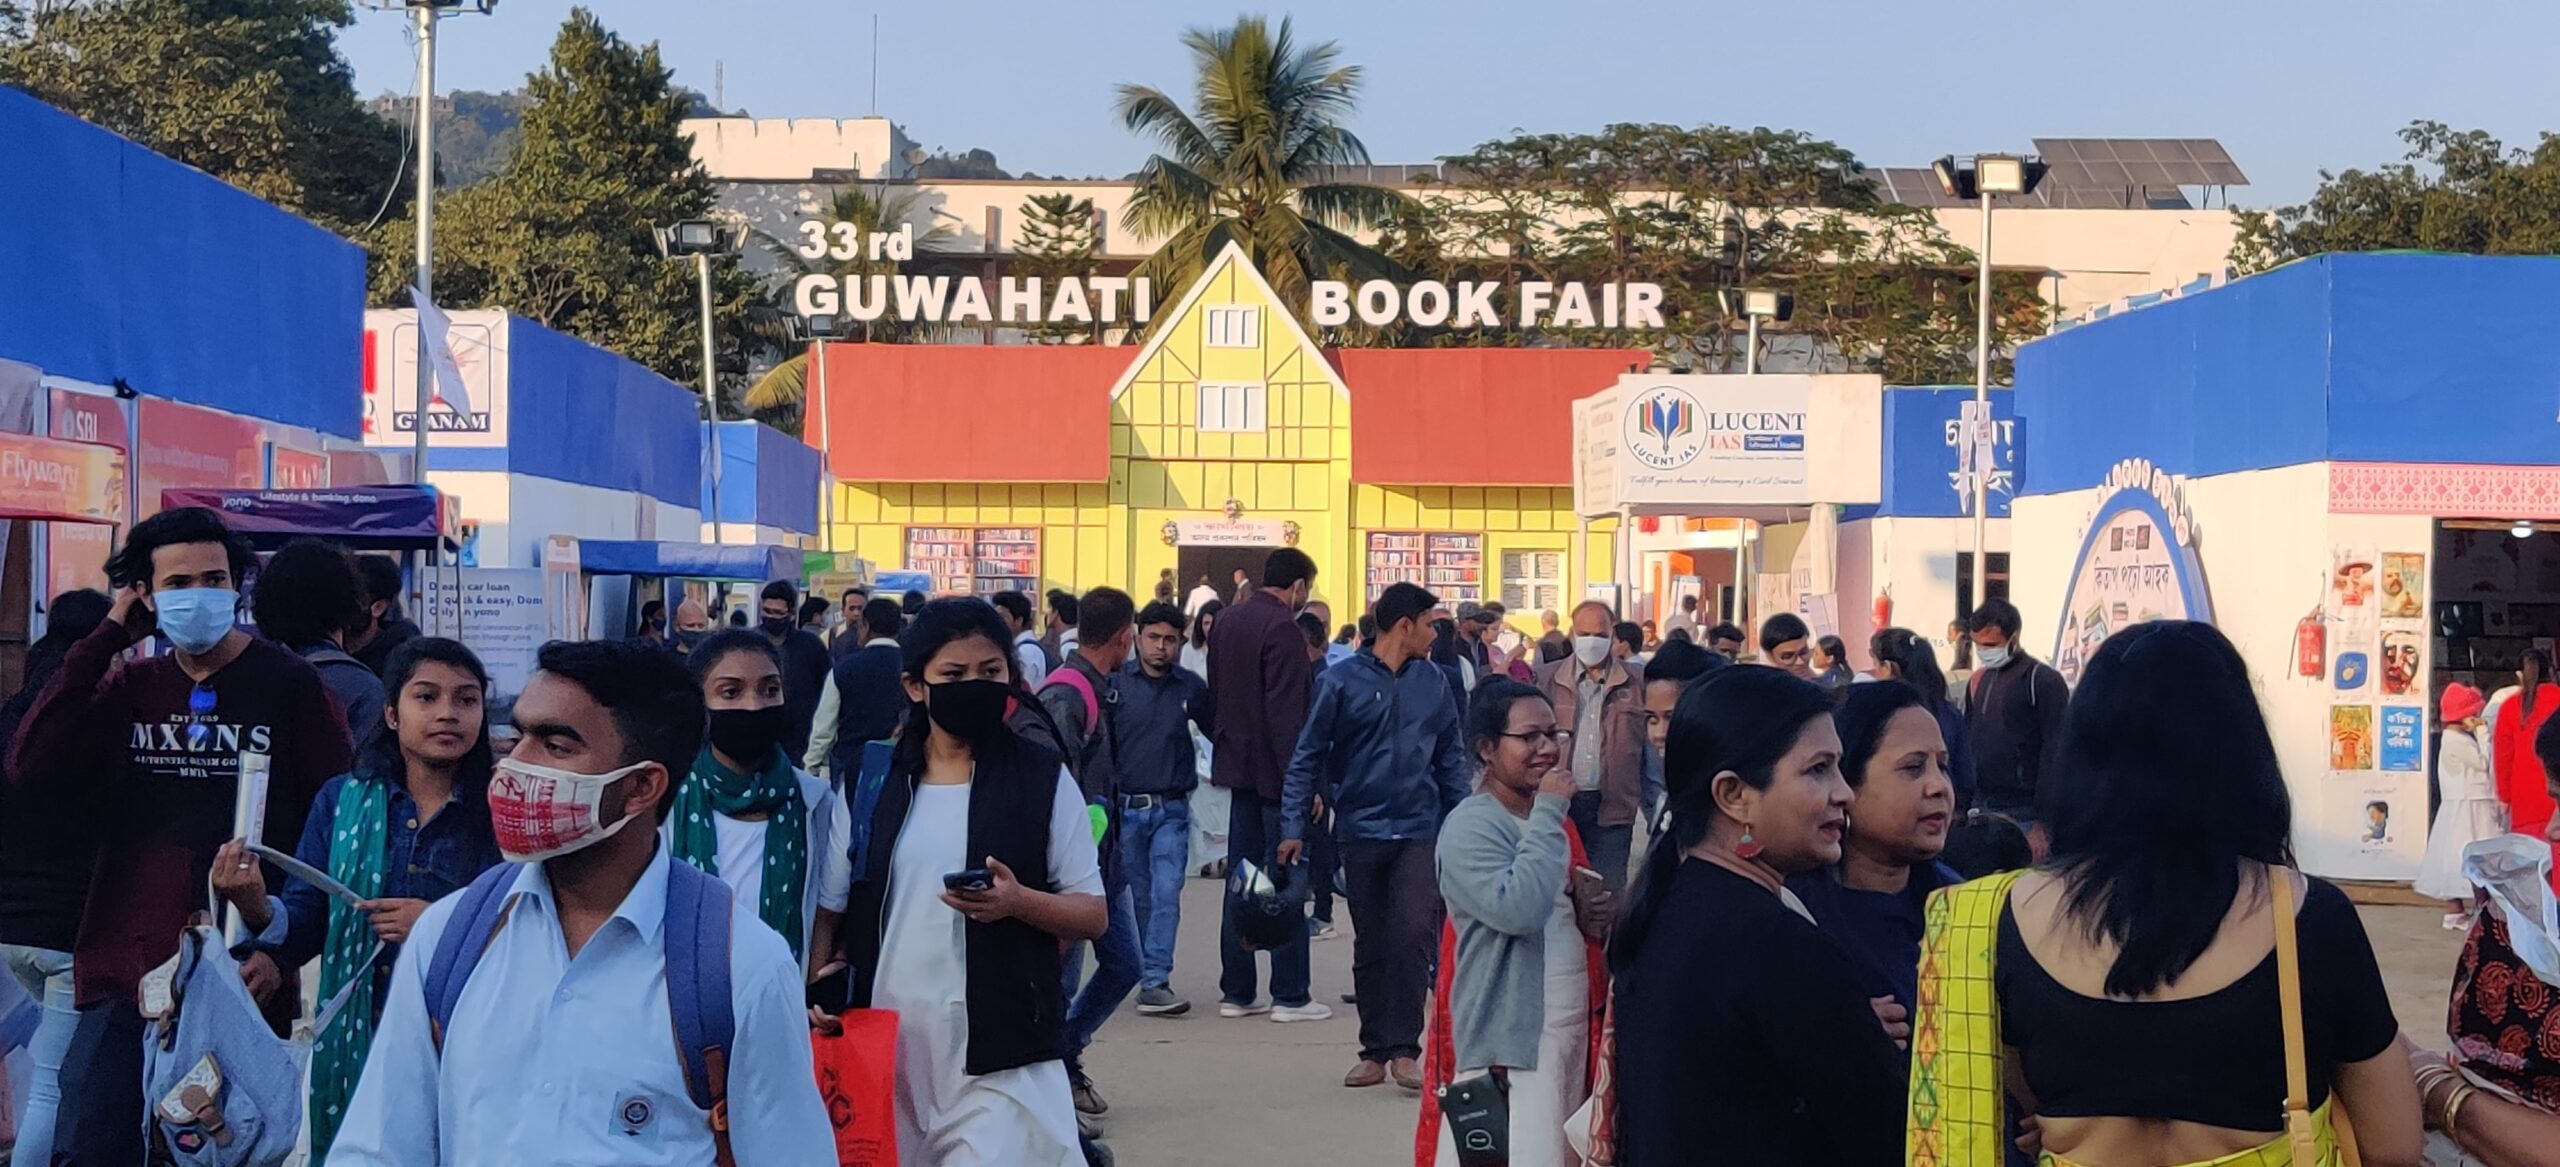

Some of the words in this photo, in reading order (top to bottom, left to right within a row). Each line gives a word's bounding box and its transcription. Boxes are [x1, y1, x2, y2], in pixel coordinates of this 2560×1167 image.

[799, 220, 859, 261] 33
[868, 222, 913, 260] rd
[795, 273, 1151, 323] GUWAHATI
[1311, 279, 1500, 327] BOOK
[1520, 281, 1665, 328] FAIR
[76, 411, 97, 442] SBI
[396, 413, 487, 431] GANAM
[1710, 412, 1806, 431] LUCENT
[1710, 434, 1741, 449] IAS
[1632, 442, 1675, 466] LUCENT
[1680, 444, 1698, 461] IAS
[222, 497, 251, 508] yono
[467, 582, 484, 591] car
[487, 582, 510, 591] loan
[476, 594, 484, 604] &
[129, 722, 271, 753] MXZNS
[134, 754, 187, 765] AUTHENTIC
